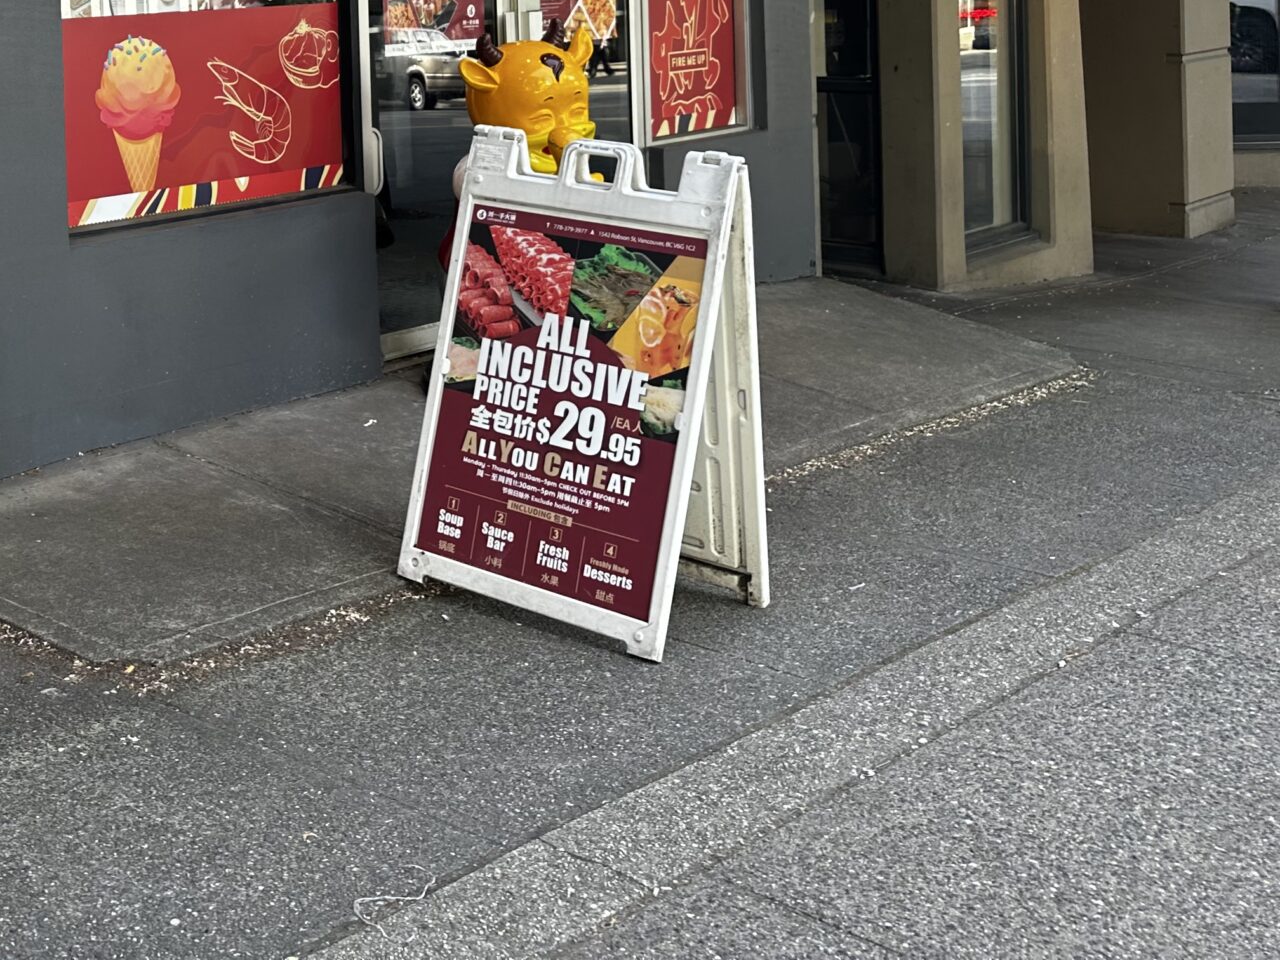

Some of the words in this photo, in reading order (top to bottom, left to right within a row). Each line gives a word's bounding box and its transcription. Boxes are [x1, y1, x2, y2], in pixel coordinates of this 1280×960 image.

[671, 56, 687, 68] FIRE
[687, 55, 696, 66] ME
[697, 53, 706, 65] UP
[536, 312, 591, 359] ALL
[477, 337, 650, 411] INCLUSIVE
[472, 373, 541, 415] PRICE
[469, 404, 536, 441] 全包价
[535, 400, 641, 467] $29.95
[463, 456, 486, 470] Monday
[492, 463, 518, 479] Thursday
[558, 483, 578, 495] CHECK
[579, 488, 592, 498] OUT
[592, 492, 616, 505] BEFORE
[616, 497, 630, 508] 5PM
[451, 499, 456, 509] 1
[510, 501, 552, 520] INCLUDING
[531, 495, 553, 508] Exclude
[554, 501, 580, 515] holidays
[593, 501, 611, 513] 5pm
[439, 508, 464, 528] Soup
[497, 513, 504, 524] 2
[437, 521, 462, 539] Base
[481, 521, 515, 543] Sauce
[552, 529, 560, 540] 3
[486, 536, 506, 552] Bar
[538, 540, 570, 561] Fresh
[606, 545, 614, 557] 4
[536, 552, 569, 573] Fruits
[589, 557, 612, 571] Freshly
[612, 562, 630, 576] Made
[540, 572, 560, 587] 水果
[583, 563, 633, 591] Desserts
[595, 589, 614, 604] 甜点
